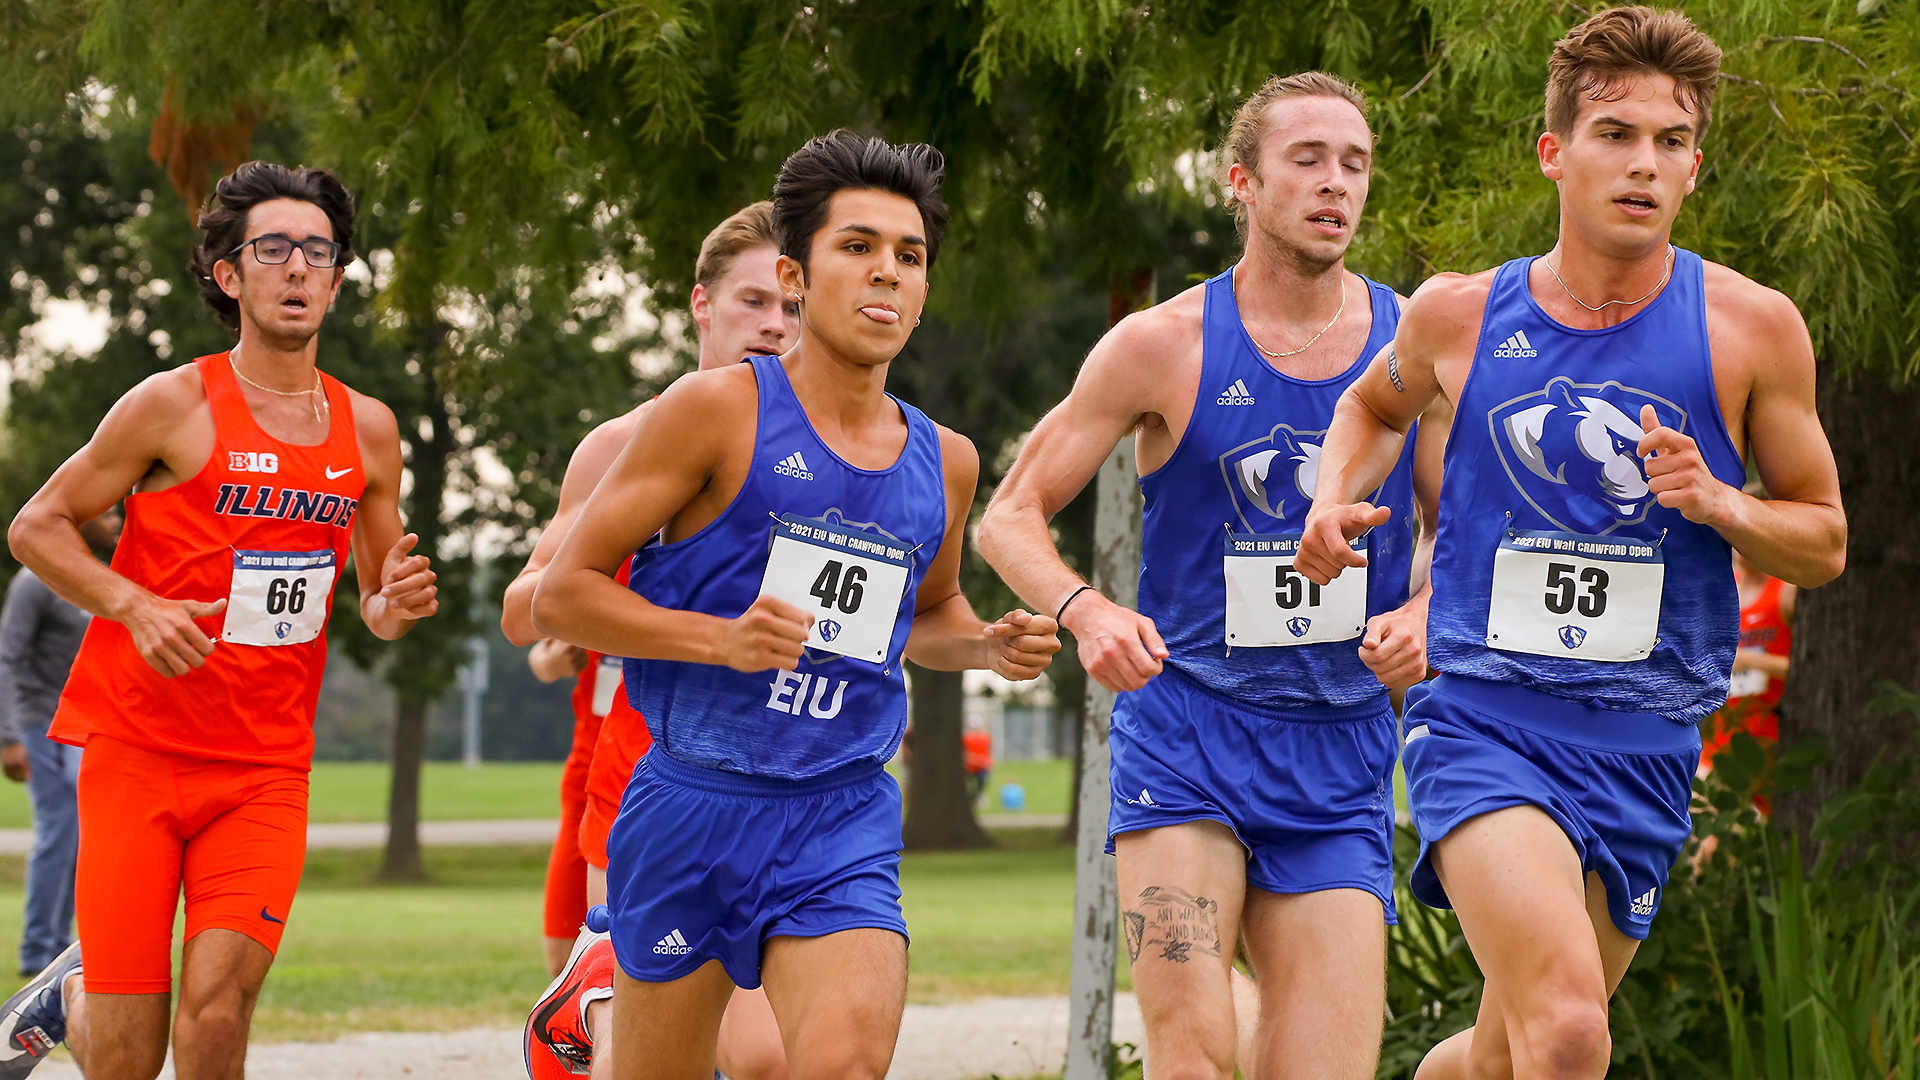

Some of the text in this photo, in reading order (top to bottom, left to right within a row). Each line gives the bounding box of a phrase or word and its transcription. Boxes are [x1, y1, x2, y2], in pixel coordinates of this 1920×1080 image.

[1493, 347, 1538, 358] adidas
[1216, 396, 1256, 406] adidas
[773, 464, 814, 481] adidas
[789, 522, 813, 538] 2021
[812, 528, 828, 541] EIU
[847, 537, 886, 556] CRAWFORD
[886, 546, 905, 561] Open
[1234, 541, 1255, 551] 2021
[1257, 541, 1271, 551] EIU
[1272, 540, 1292, 551] Walt
[1512, 537, 1653, 558] 2021 EIU Walt CRAWFORD Open
[266, 577, 308, 615] 66
[809, 559, 868, 615] 46
[1275, 565, 1321, 610] 51
[1544, 562, 1610, 618] 53
[765, 668, 849, 720] EIU
